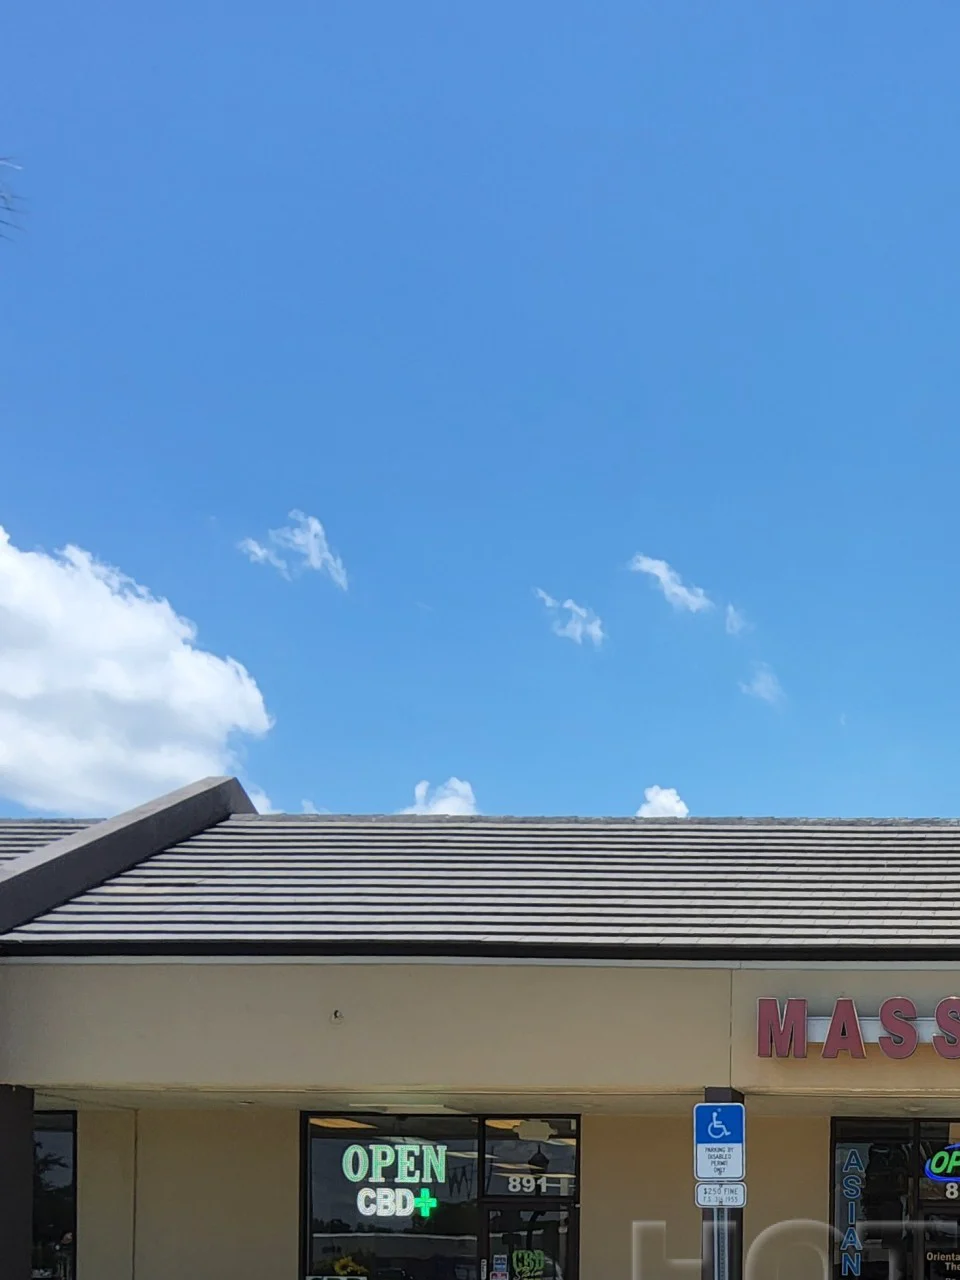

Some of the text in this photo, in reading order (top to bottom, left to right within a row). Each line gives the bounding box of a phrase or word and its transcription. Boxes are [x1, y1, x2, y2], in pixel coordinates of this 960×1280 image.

[342, 1144, 447, 1183] OPEN
[508, 1176, 548, 1193] 891
[703, 1187, 738, 1196] $250 FINE
[840, 1149, 864, 1277] ASIAN
